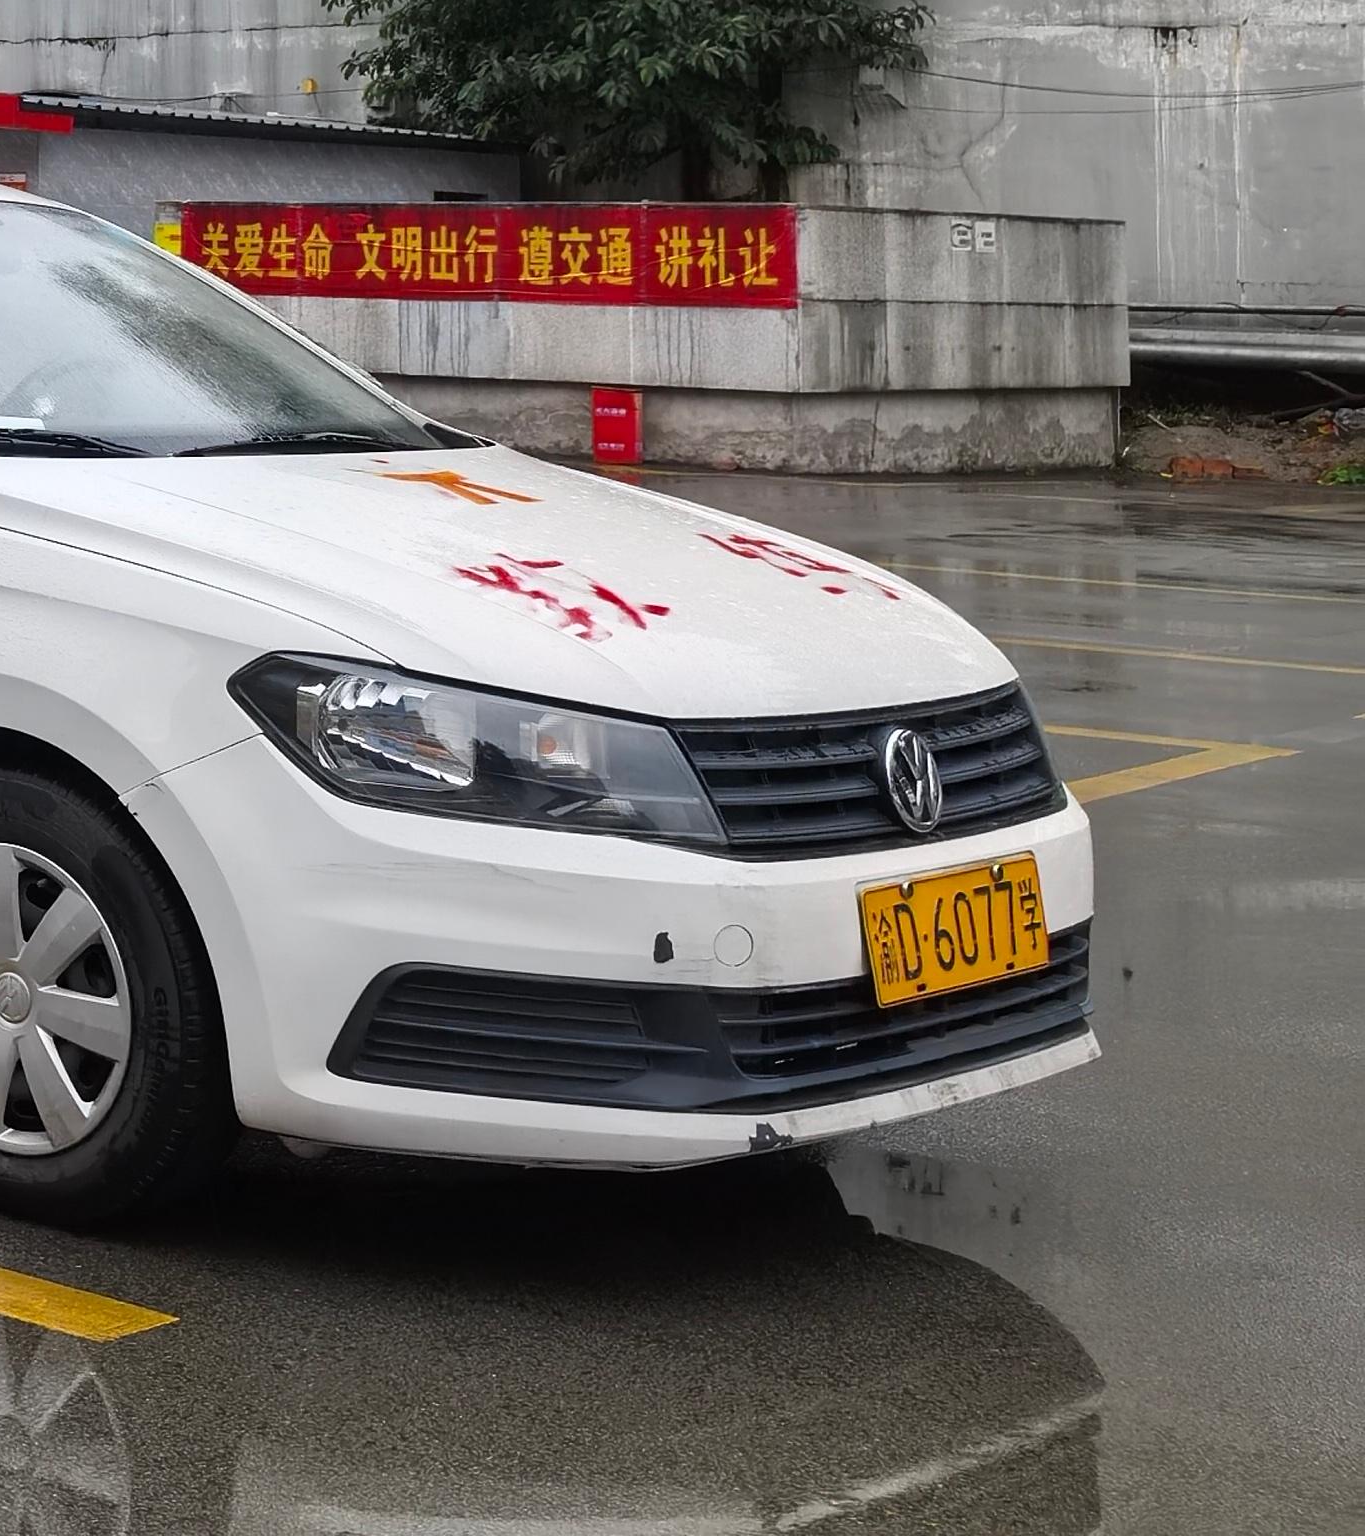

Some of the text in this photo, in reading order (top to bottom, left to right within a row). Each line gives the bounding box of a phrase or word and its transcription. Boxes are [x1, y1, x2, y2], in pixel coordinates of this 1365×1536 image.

[201, 222, 779, 288] 关爱生命 文明出行 遵交通 讲礼让
